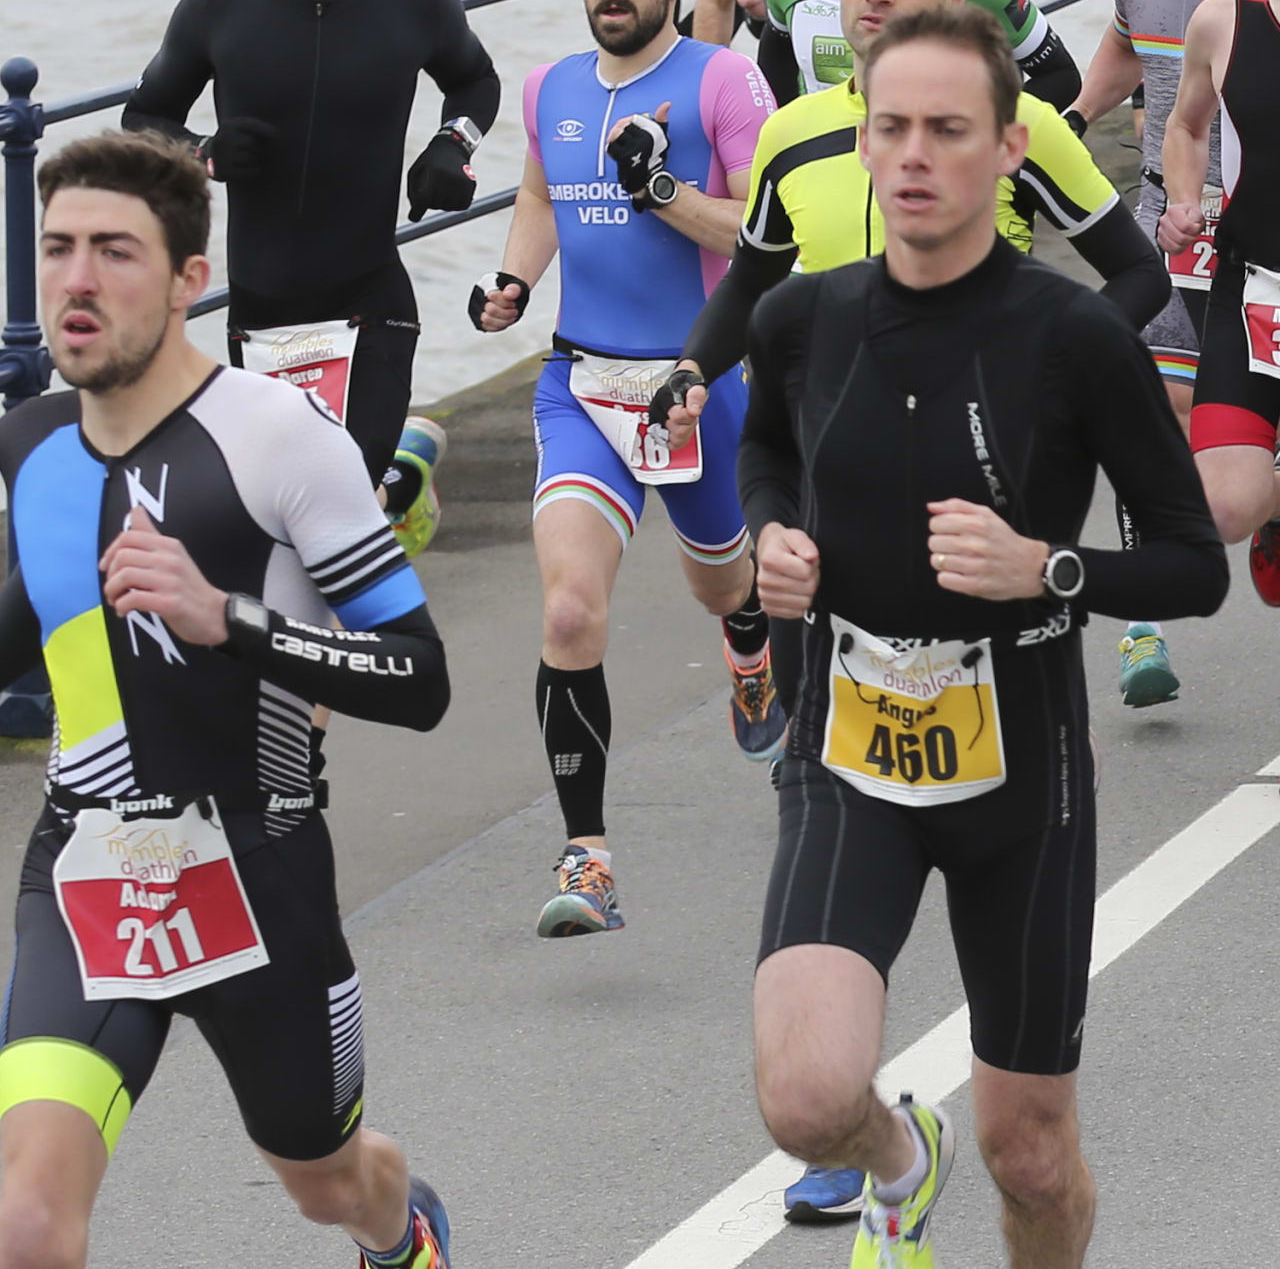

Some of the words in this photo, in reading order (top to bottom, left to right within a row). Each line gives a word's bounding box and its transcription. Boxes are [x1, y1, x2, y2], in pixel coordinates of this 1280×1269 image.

[815, 42, 845, 55] aim
[745, 71, 763, 107] VELO
[577, 207, 630, 225] VELO
[600, 370, 666, 392] mumble
[610, 388, 655, 403] duathl
[967, 401, 989, 461] MORE
[864, 724, 959, 783] 460
[117, 906, 206, 976] 211
